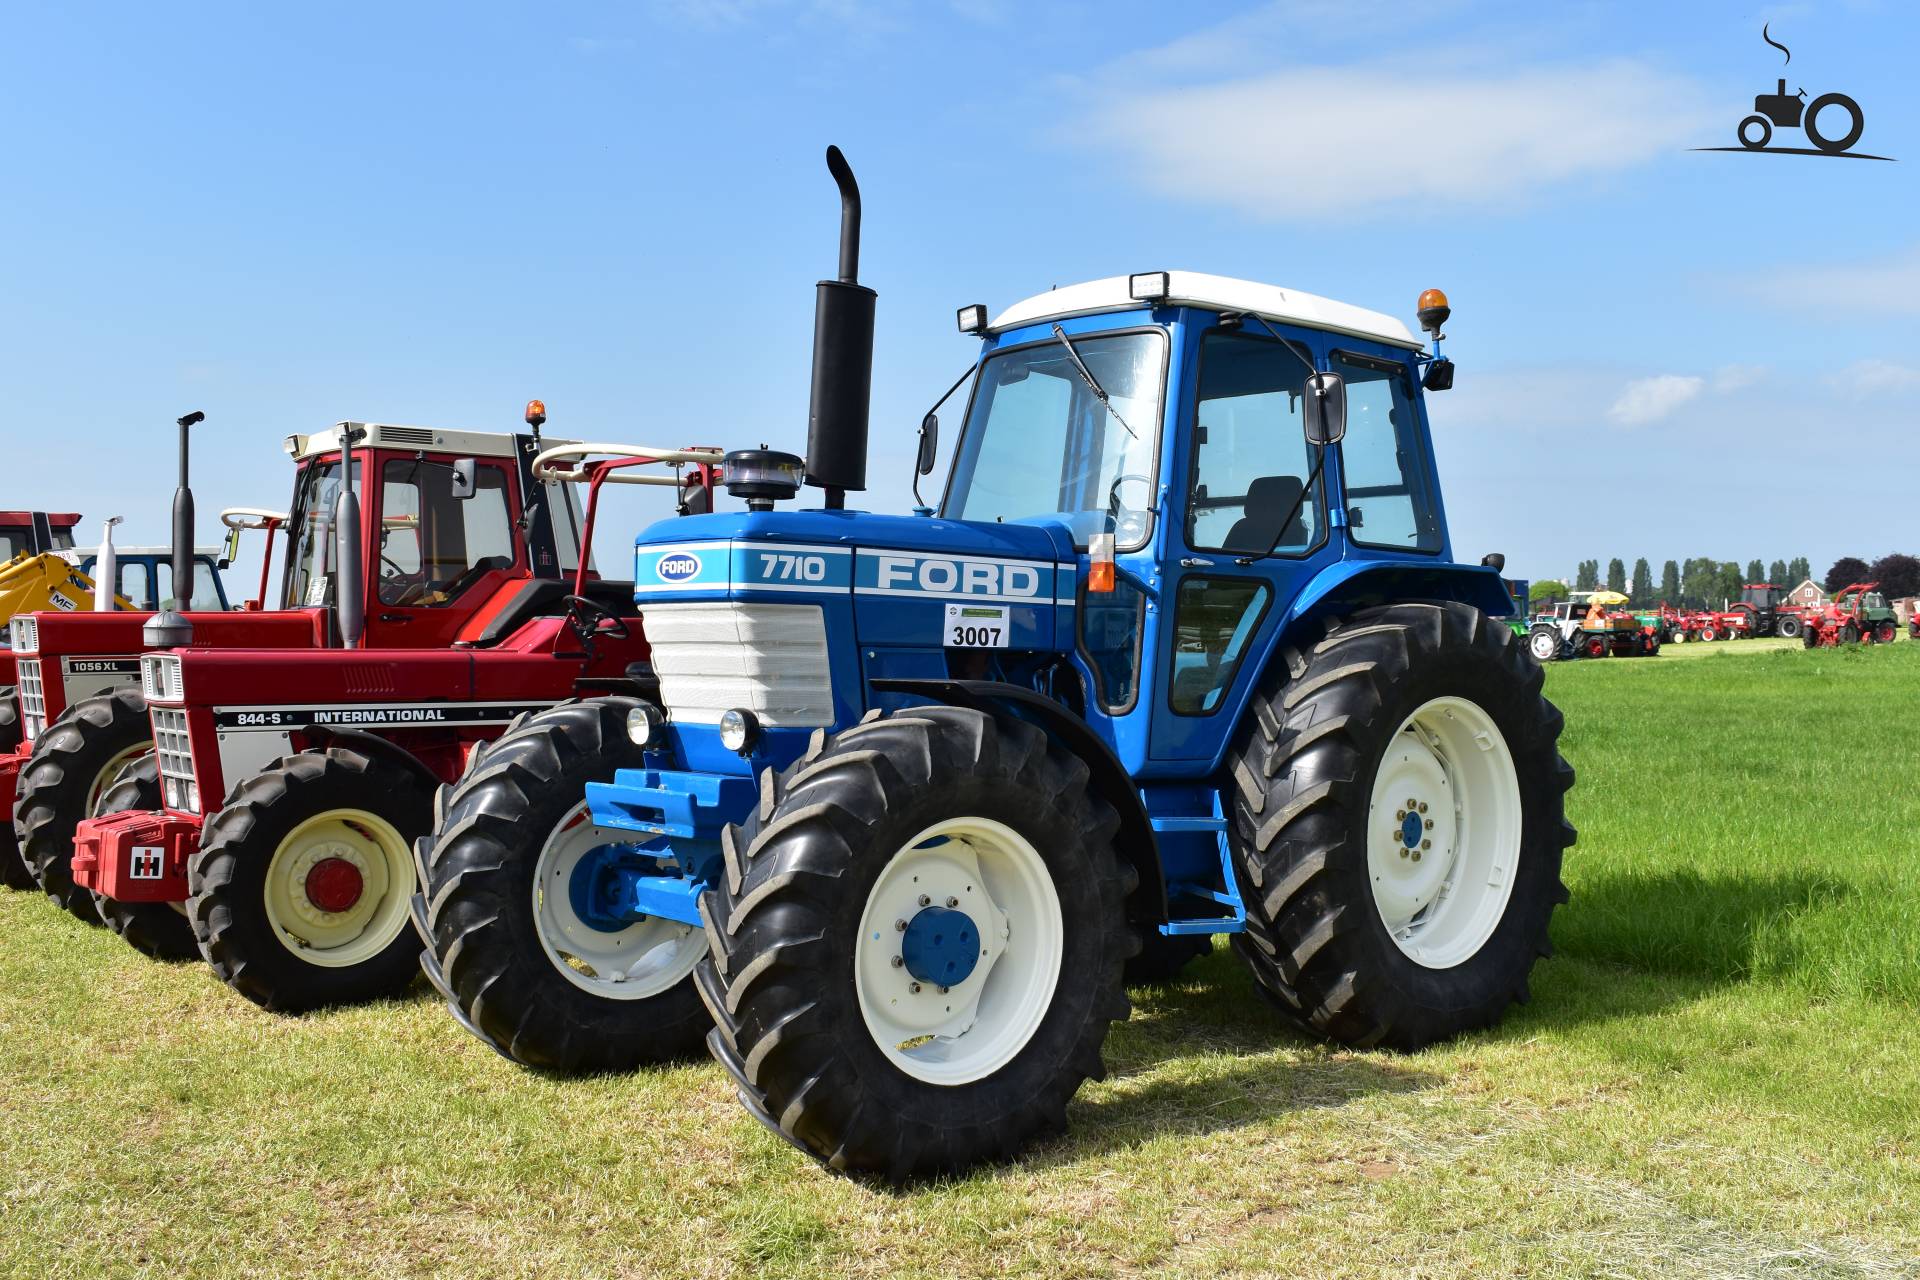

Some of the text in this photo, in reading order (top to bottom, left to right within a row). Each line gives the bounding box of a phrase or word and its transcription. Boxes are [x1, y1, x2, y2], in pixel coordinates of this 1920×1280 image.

[662, 560, 695, 575] FORD
[760, 553, 825, 581] 7710
[877, 556, 1039, 597] FORD
[52, 594, 74, 610] MF
[952, 626, 1002, 647] 3007
[74, 661, 119, 671] 1056 XL
[237, 709, 446, 725] 844-S INTERNATIONAL
